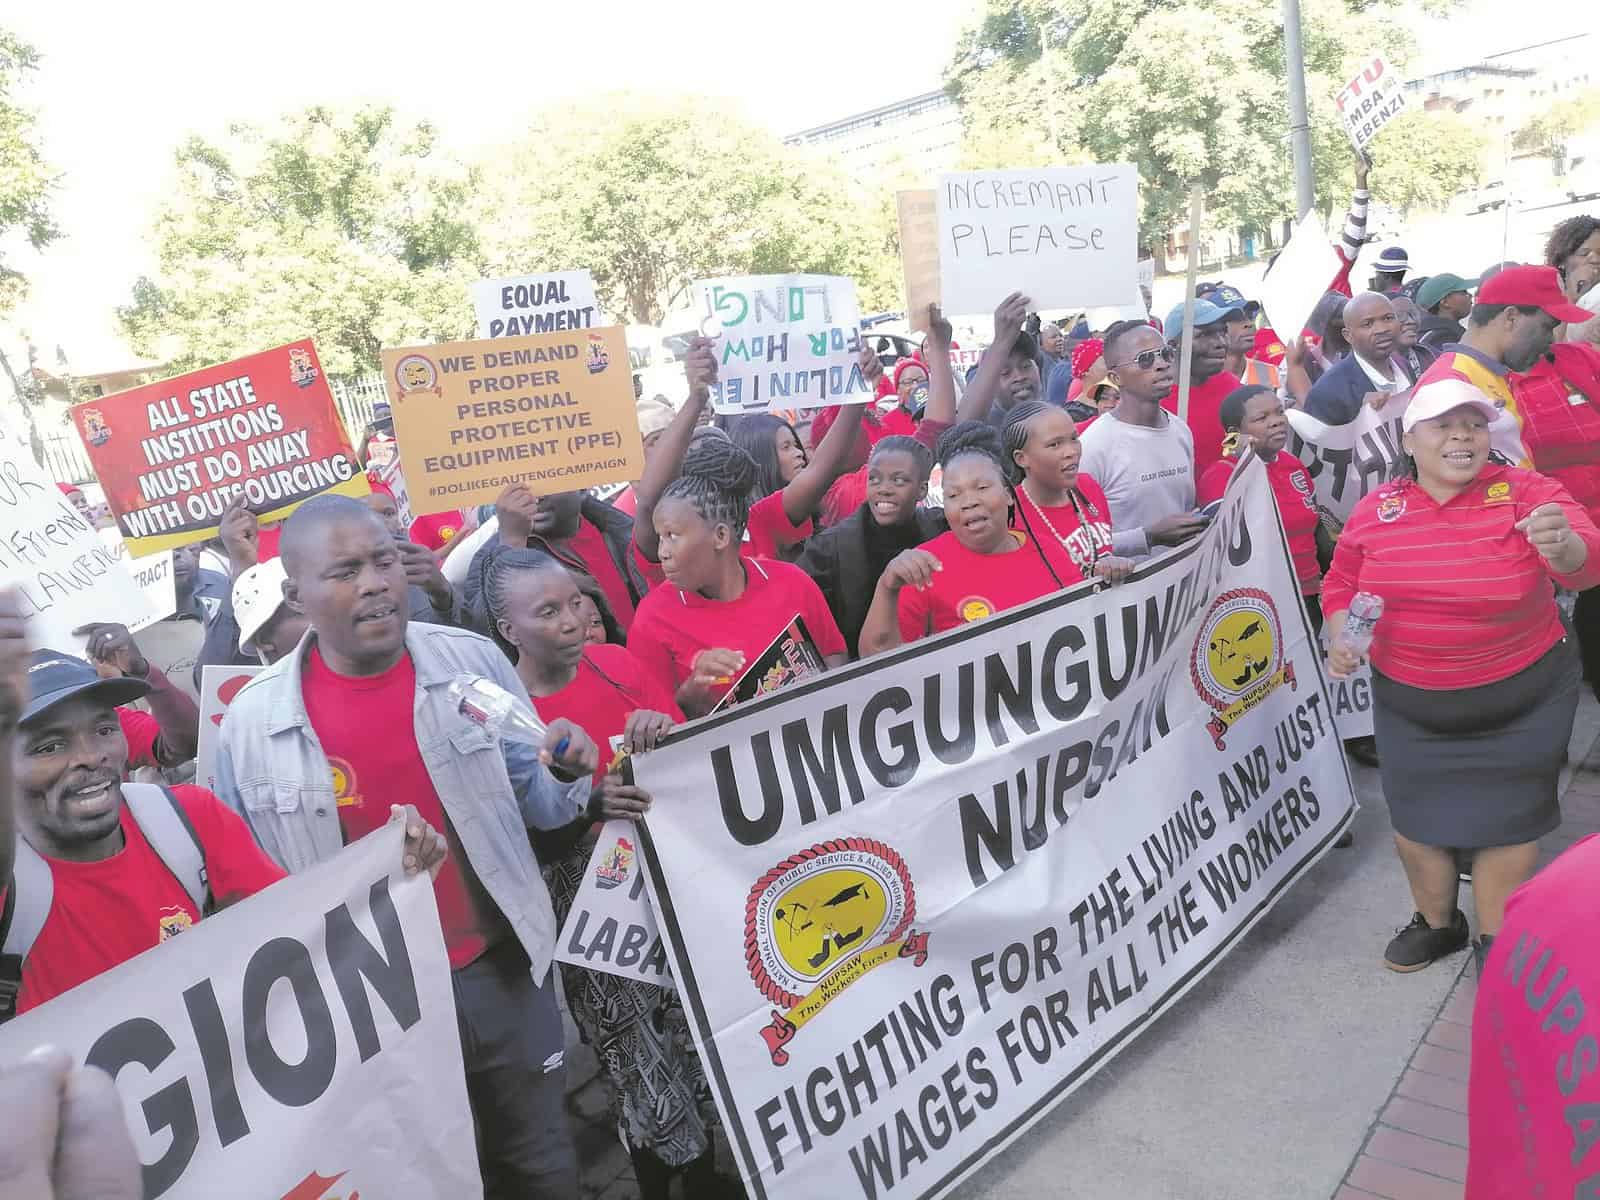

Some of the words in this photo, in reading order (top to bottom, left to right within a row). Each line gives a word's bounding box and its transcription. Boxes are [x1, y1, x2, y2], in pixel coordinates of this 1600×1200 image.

[1355, 94, 1405, 144] EBENZI
[947, 175, 1119, 213] INCREMANT
[502, 280, 570, 309] EQUAL
[490, 306, 594, 338] PAYMENT
[439, 355, 477, 374] WE
[484, 344, 579, 369] DEMAND
[722, 332, 788, 365] HOW
[808, 327, 862, 356] FOR
[469, 370, 560, 394] PROPER
[146, 397, 189, 431] ALL
[189, 376, 257, 416] STATE
[457, 392, 578, 420] PERSONAL
[141, 404, 284, 466] INSTITTIONS
[451, 412, 592, 445] PROTECTIVE
[138, 462, 202, 502] MUST
[203, 449, 242, 484] DO
[247, 430, 311, 473] AWAY
[424, 440, 559, 473] EQUIPMENT
[567, 431, 622, 455] (PPE)
[122, 505, 185, 538] WITH
[187, 454, 352, 521] OUTSOURCING
[429, 458, 627, 497] #DOLIKEGAUTENGCAMPAIGN
[1330, 678, 1370, 716] AG
[779, 863, 813, 885] PUBLIC
[815, 853, 856, 866] SERVICE
[766, 884, 779, 897] OF
[754, 974, 965, 1175] FIGHTING
[970, 926, 1059, 1014] FOR
[1069, 868, 1135, 955] THE
[1126, 790, 1217, 903] LIVING
[1217, 748, 1273, 824] AND
[1274, 692, 1326, 774] JUST
[759, 898, 769, 936] UNION
[568, 910, 672, 976] LABA
[762, 939, 789, 986] NATIONAL
[820, 952, 862, 993] NUPSAW
[797, 999, 821, 1018] The
[822, 969, 861, 1003] Workers
[862, 951, 889, 970] First
[848, 1046, 1000, 1200] WAGES
[997, 988, 1080, 1085] FOR
[1087, 943, 1150, 1025] ALL
[1147, 886, 1209, 967] THE
[1198, 775, 1323, 917] WORKERS
